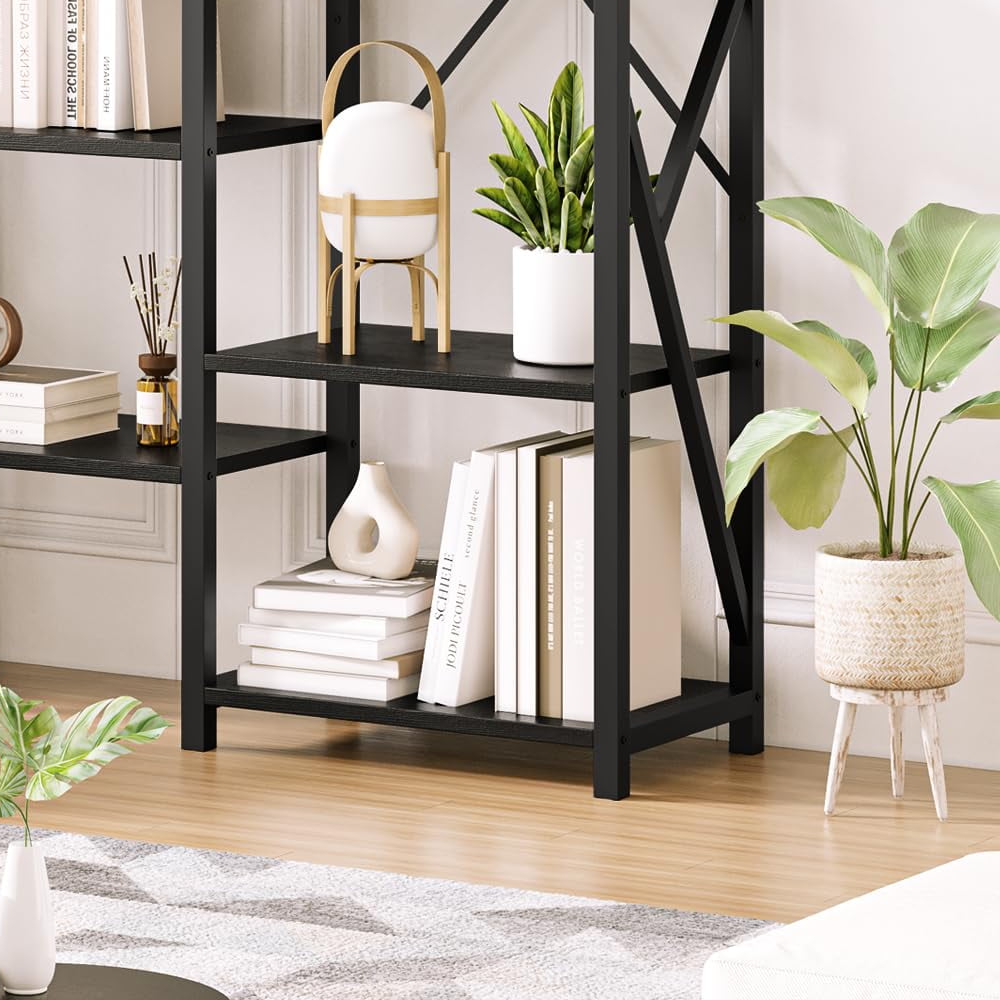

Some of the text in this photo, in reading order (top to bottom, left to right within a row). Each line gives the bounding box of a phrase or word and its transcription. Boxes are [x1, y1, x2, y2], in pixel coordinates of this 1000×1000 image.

[18, 45, 31, 100] ЖИЗНИ
[469, 488, 480, 522] glance
[464, 525, 475, 559] second
[435, 552, 455, 622] SCHIELE
